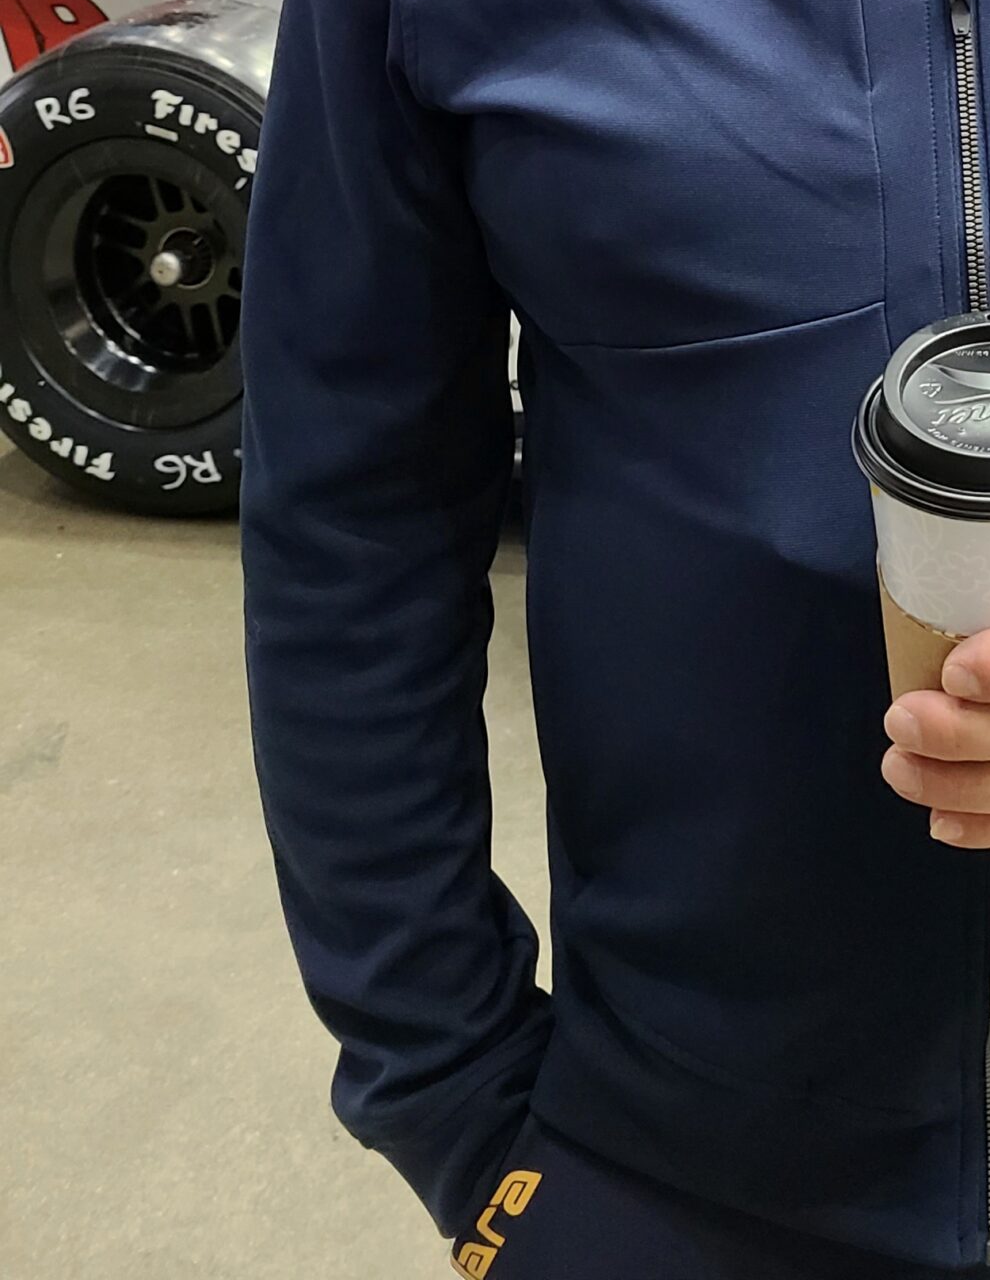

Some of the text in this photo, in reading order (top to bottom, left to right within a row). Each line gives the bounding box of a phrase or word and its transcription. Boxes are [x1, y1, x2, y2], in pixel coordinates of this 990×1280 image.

[34, 87, 96, 130] R6
[151, 89, 259, 174] Fires
[0, 382, 115, 481] Firest
[153, 450, 223, 490] R6
[457, 1170, 542, 1280] ara
